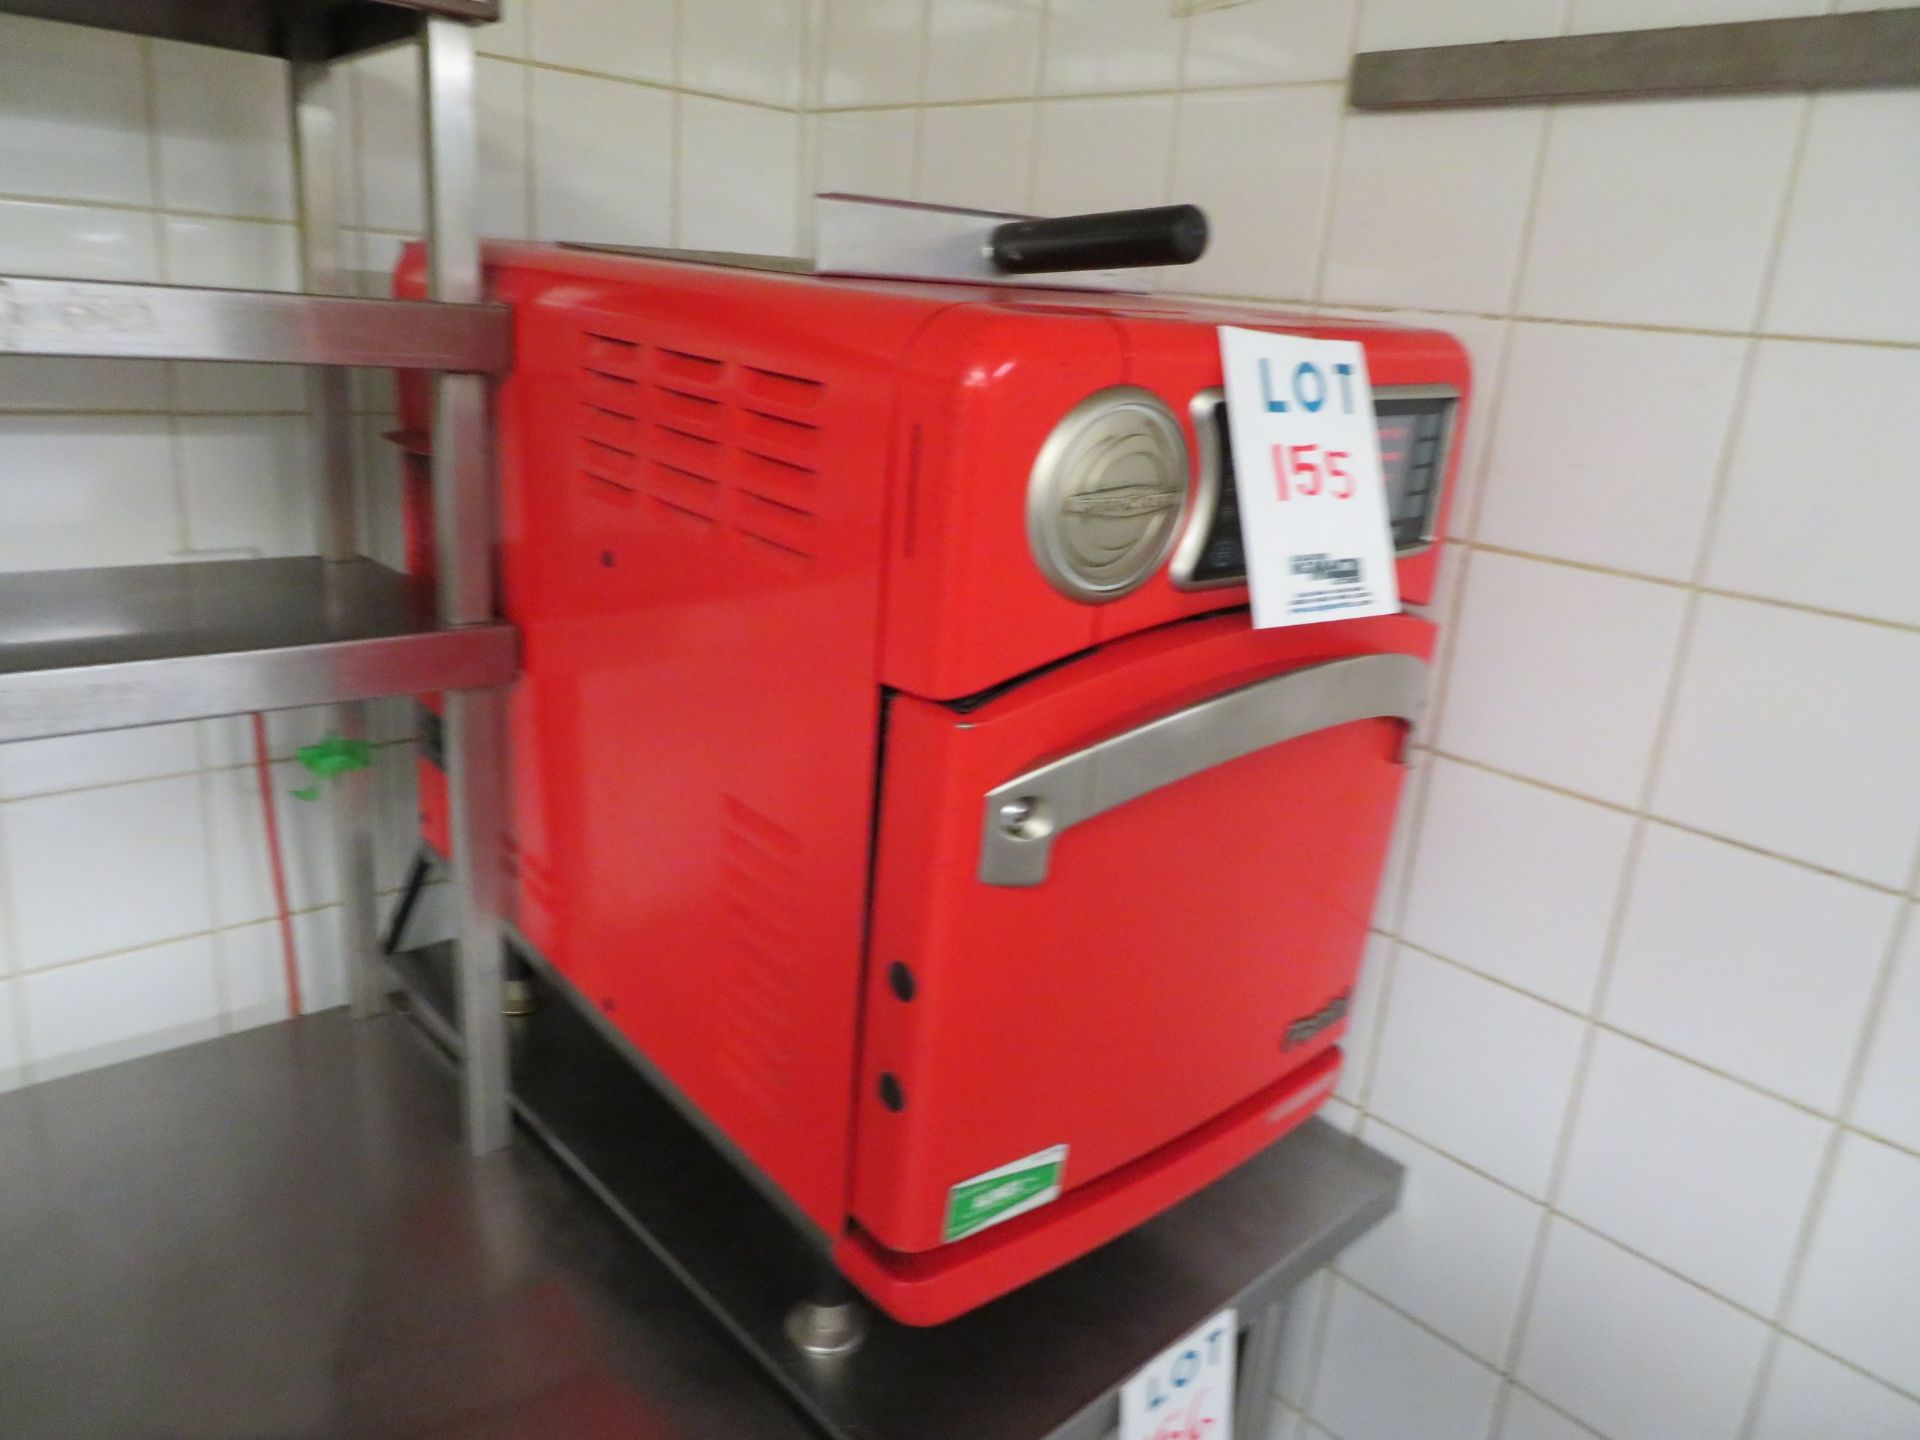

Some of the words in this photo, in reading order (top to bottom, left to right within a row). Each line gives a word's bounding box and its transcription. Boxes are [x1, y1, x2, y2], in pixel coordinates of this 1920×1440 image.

[1258, 357, 1355, 415] LOT
[1270, 442, 1356, 502] 155
[1146, 1329, 1224, 1410] LOT
